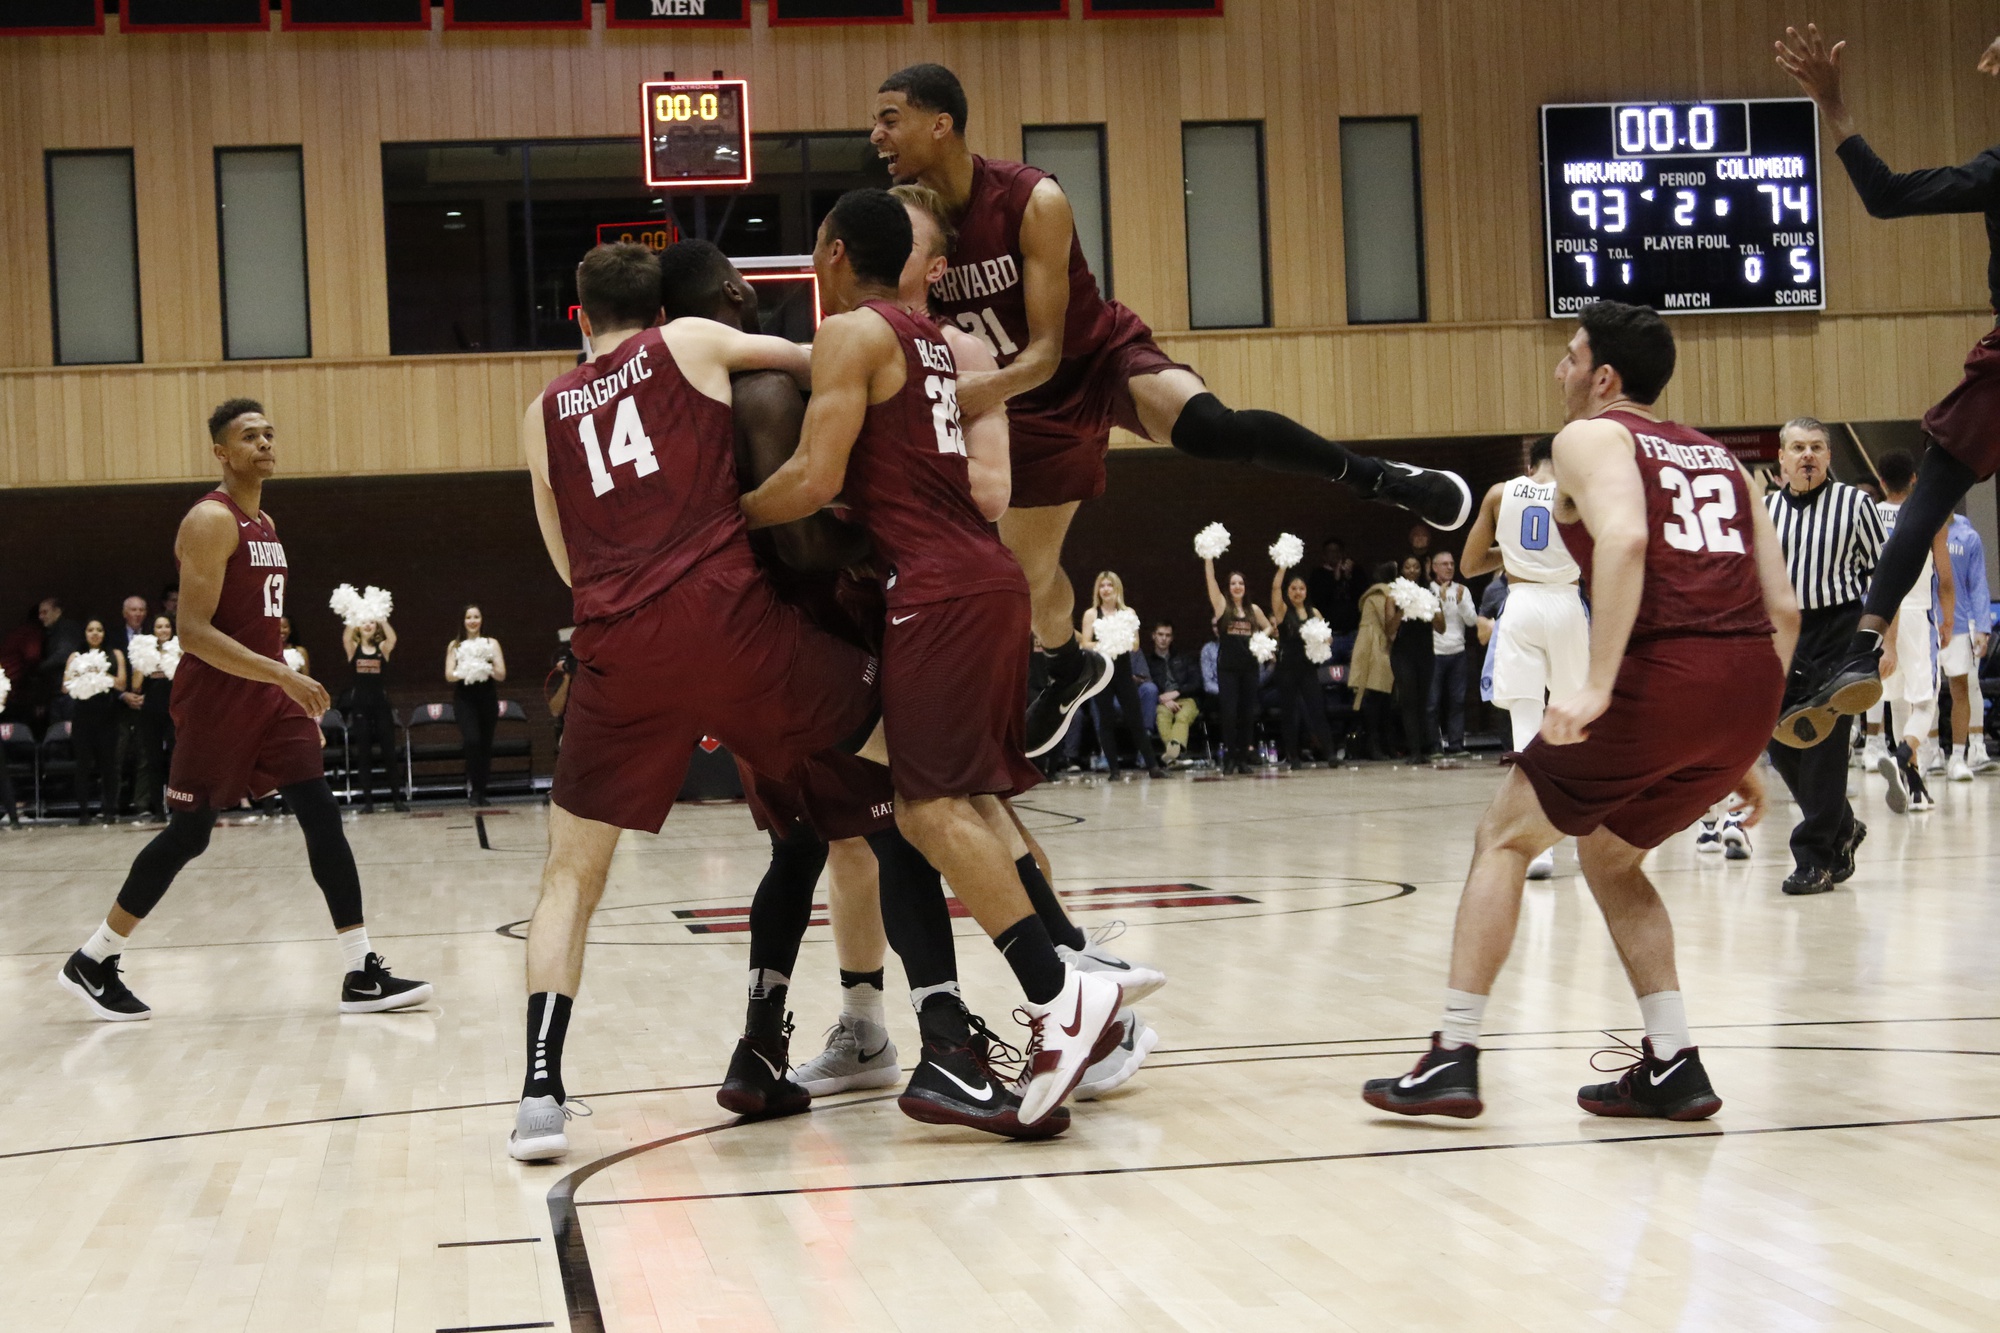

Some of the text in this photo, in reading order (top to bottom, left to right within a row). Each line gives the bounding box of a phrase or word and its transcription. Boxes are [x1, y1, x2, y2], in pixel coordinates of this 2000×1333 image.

[651, 0, 705, 15] MEN
[656, 93, 719, 122] 00.0
[1619, 107, 1715, 152] 00.0
[1563, 161, 1644, 185] HARVARD
[1659, 172, 1706, 187] PERIOD
[1716, 156, 1804, 180] COLUMBIA
[1570, 188, 1627, 233] 93
[1673, 191, 1695, 226] 2
[1756, 184, 1809, 225] 74
[1555, 238, 1599, 253] FOULS
[1643, 234, 1731, 251] PLAYER FOUL
[1772, 232, 1815, 247] FOULS
[931, 254, 1019, 302] ARVARD
[1574, 254, 1594, 288] 7
[1621, 262, 1631, 285] 1
[1744, 257, 1761, 284] 0
[1789, 247, 1812, 284] 5
[1664, 292, 1711, 309] MATCH
[1774, 289, 1818, 305] SCORE
[578, 394, 660, 498] 14
[1635, 432, 1735, 471] FENBERG
[1658, 466, 1746, 554] 32
[1520, 505, 1550, 551] 0
[1946, 541, 1964, 556] BIA
[263, 574, 285, 617] 13
